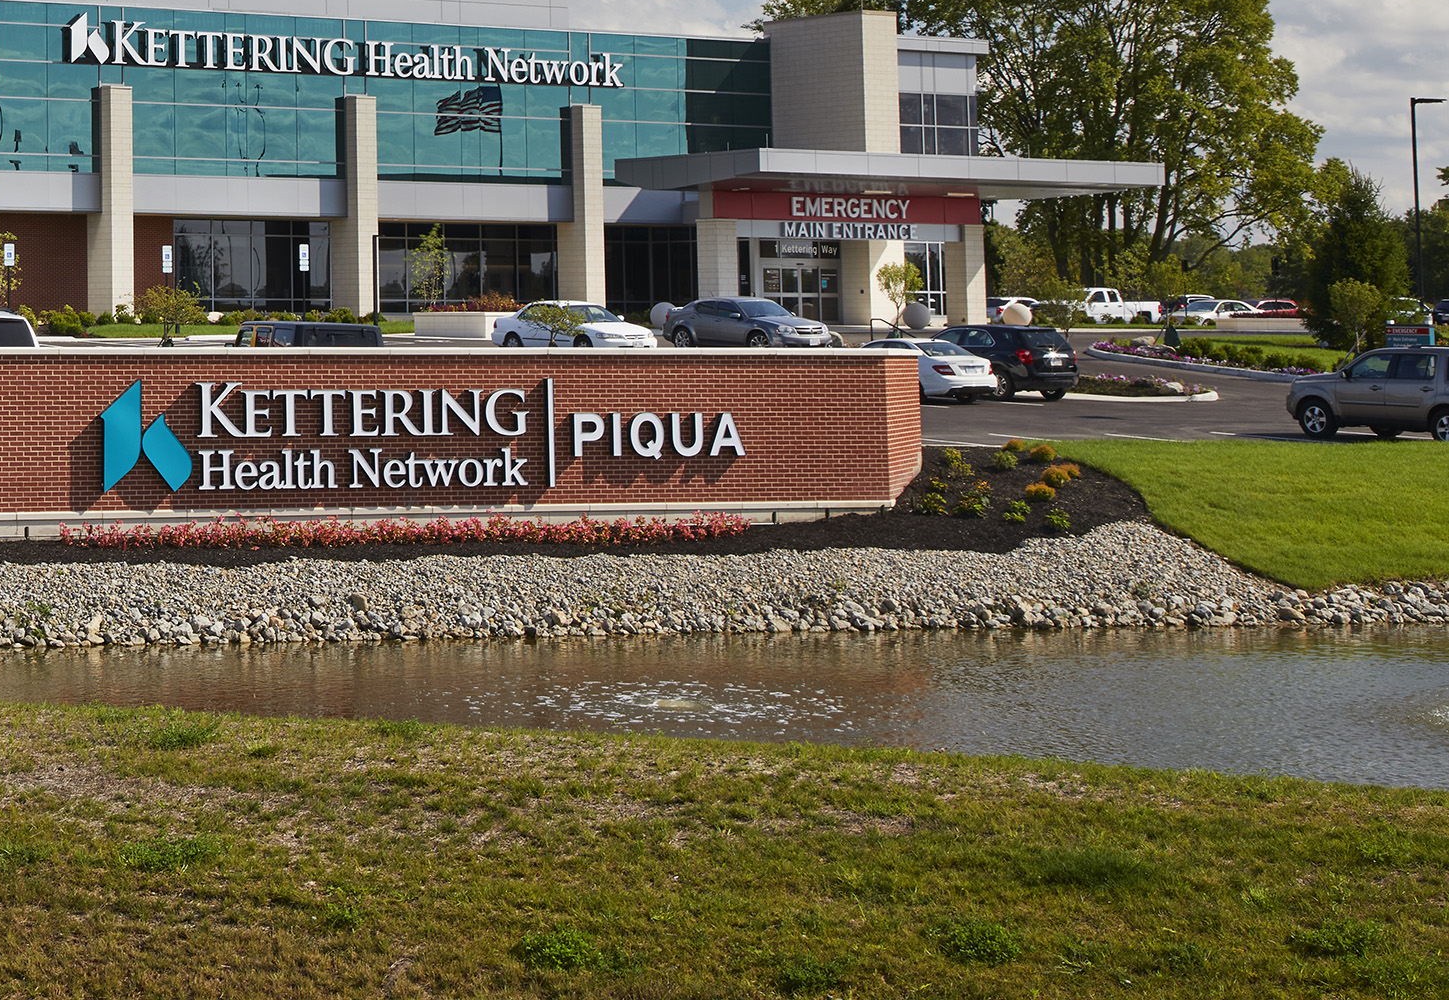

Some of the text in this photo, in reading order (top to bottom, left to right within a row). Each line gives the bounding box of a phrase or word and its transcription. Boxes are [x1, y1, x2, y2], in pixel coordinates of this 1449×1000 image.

[111, 20, 624, 87] KETTERING Health Network
[791, 196, 910, 220] EMERGENCY
[774, 244, 838, 256] 1 Kettering Way
[783, 221, 919, 240] MAIN ENTRANCE
[195, 382, 530, 438] KETTERING
[573, 412, 747, 460] PIQUA
[198, 447, 529, 491] Health Network
